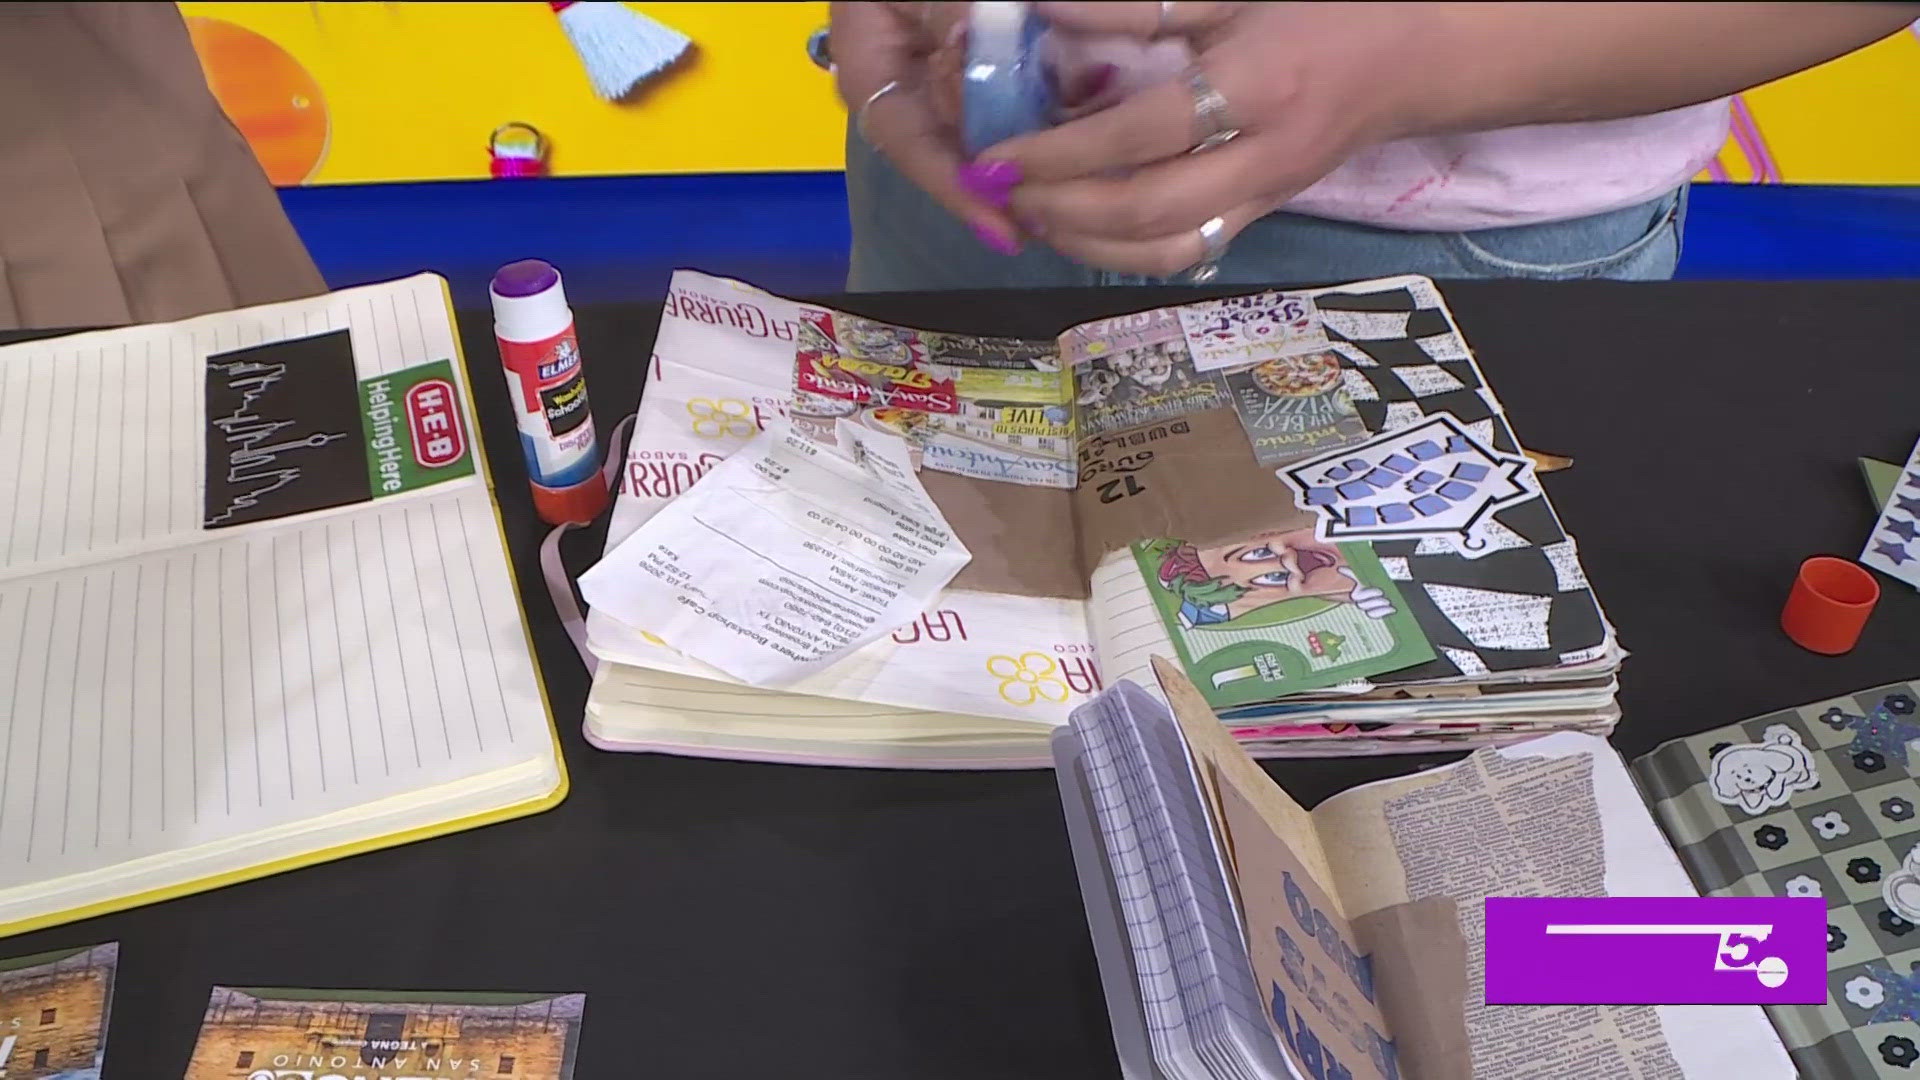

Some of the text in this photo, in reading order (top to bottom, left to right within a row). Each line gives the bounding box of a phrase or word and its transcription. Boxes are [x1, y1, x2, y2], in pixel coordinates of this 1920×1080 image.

[820, 354, 933, 389] Tacos
[802, 373, 952, 411] San Antonio
[1261, 396, 1334, 415] PIZZA
[1009, 408, 1045, 424] LIVE
[1254, 412, 1305, 432] BEST
[1096, 475, 1146, 504] 12
[677, 595, 705, 615] Cafe
[707, 611, 768, 646] Bookshop
[371, 1040, 417, 1051] TEGNA
[271, 1054, 481, 1072] SAN ANTONIO
